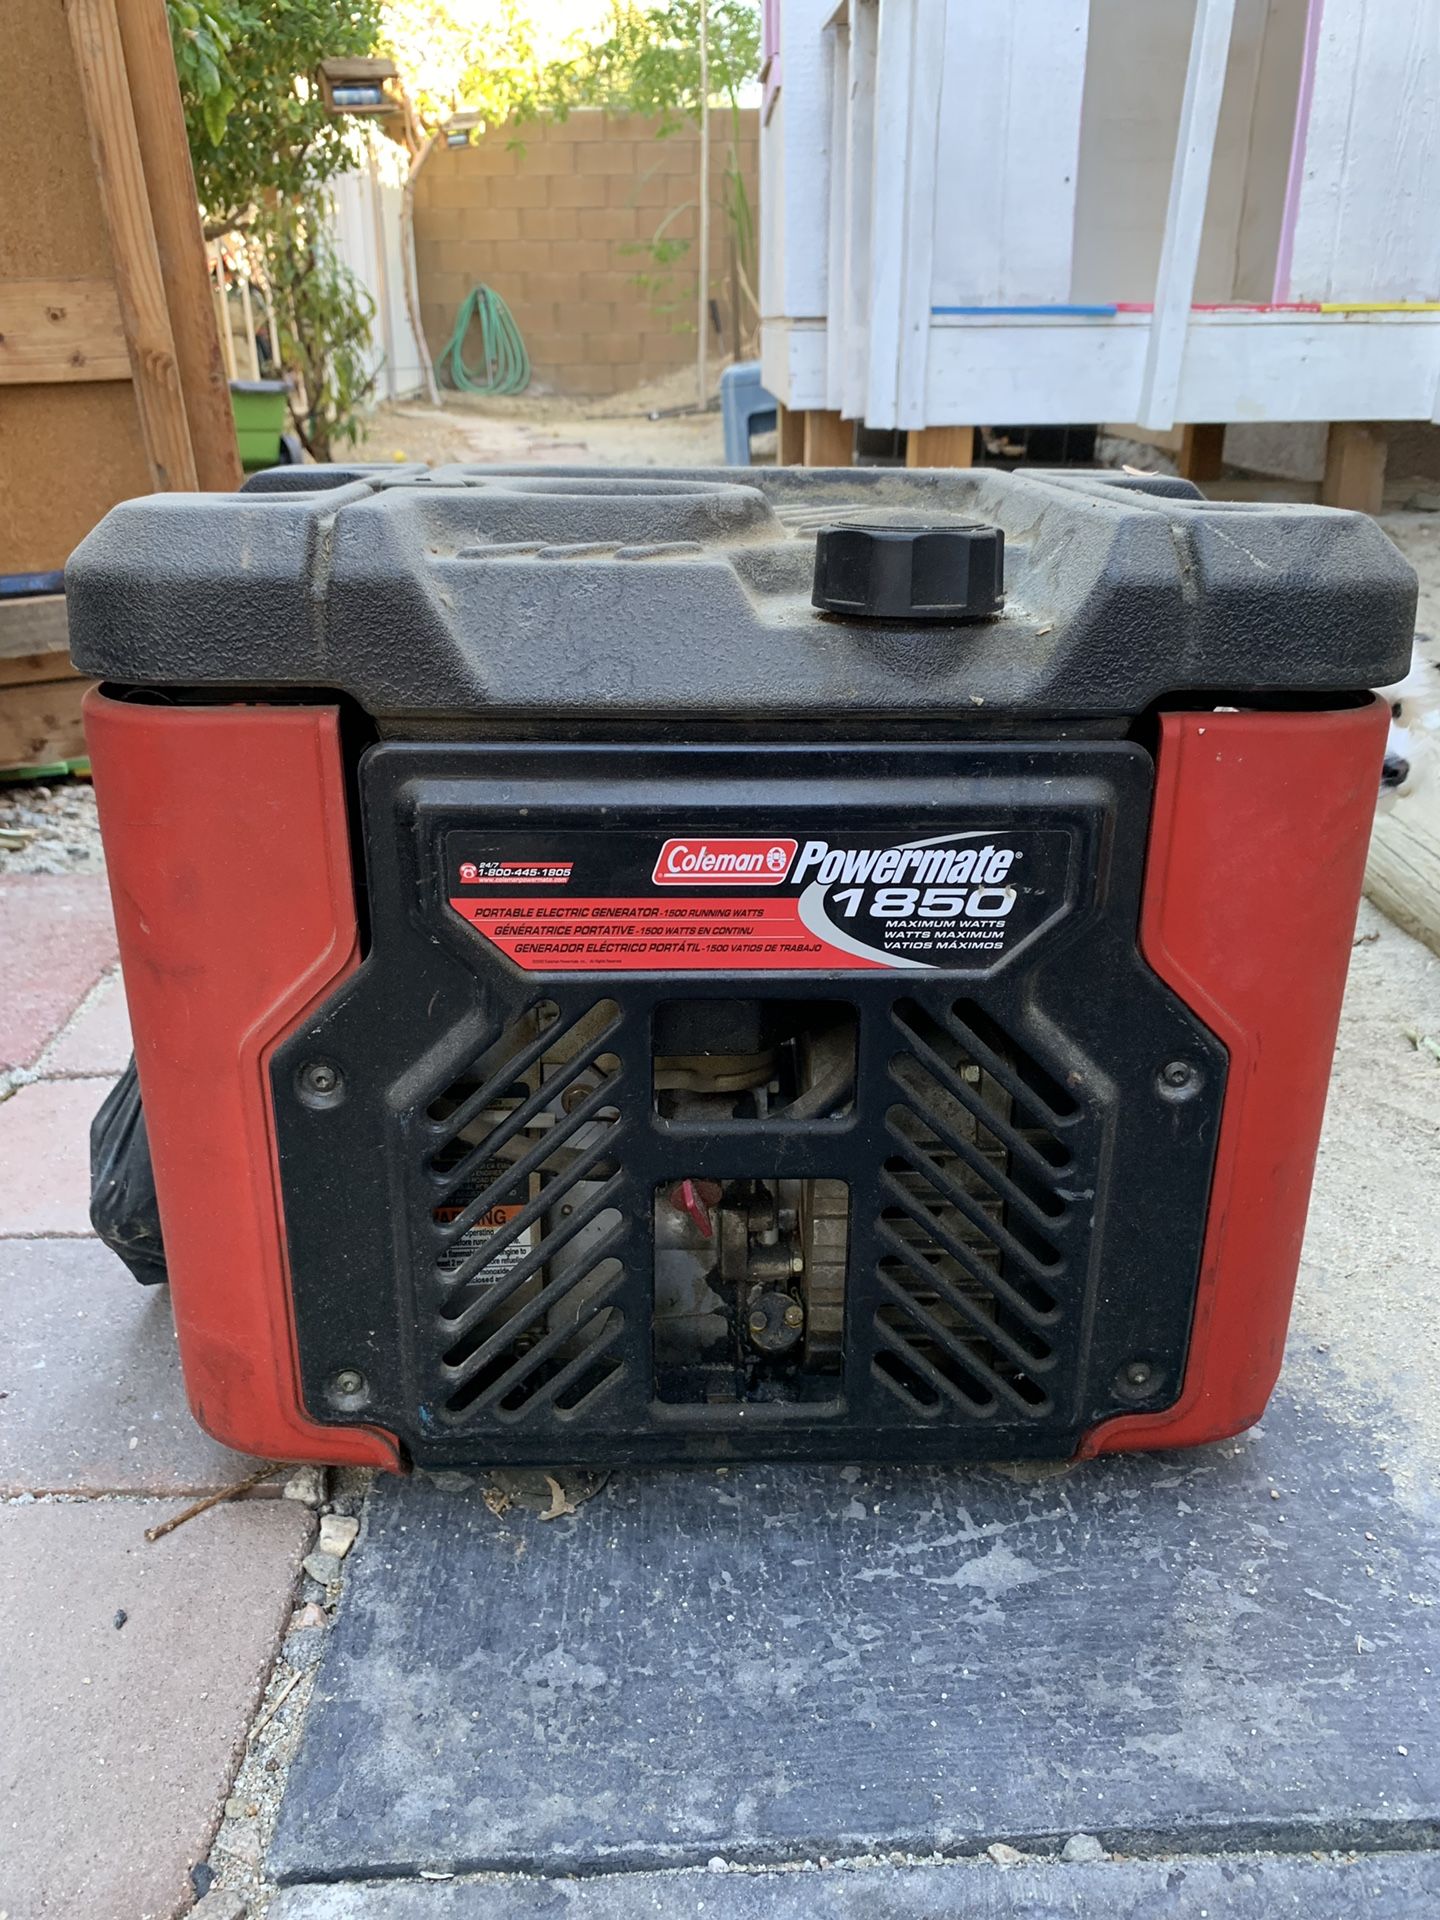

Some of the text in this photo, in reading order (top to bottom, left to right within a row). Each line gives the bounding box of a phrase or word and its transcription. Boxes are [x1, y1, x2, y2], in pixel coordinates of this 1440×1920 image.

[667, 846, 764, 873] Coleman
[832, 888, 1017, 917] 1850
[475, 908, 534, 917] PORTABLE
[536, 908, 590, 917] ELECTRIC
[591, 908, 659, 917] GENERATOR
[688, 909, 731, 917] RUNNING
[732, 909, 764, 917] WATTS
[494, 923, 572, 935] GÉNÉRATRICE
[573, 926, 635, 935] PORTATIVE
[665, 927, 696, 935] WATTS
[697, 927, 711, 935] EN
[712, 927, 754, 935] CONTINU
[885, 920, 1006, 928] MAXIMUM WATTS
[883, 931, 1004, 939] WATTS MAXIMUM
[514, 943, 584, 953] GENERADOR
[586, 940, 647, 953] ELÉCTRICO
[648, 940, 701, 953] PORTÁTIL
[731, 944, 763, 952] VATIOS
[764, 944, 778, 952] DE
[779, 944, 822, 952] TRABAJO
[883, 939, 1004, 949] VATIOS MÁXIMOS
